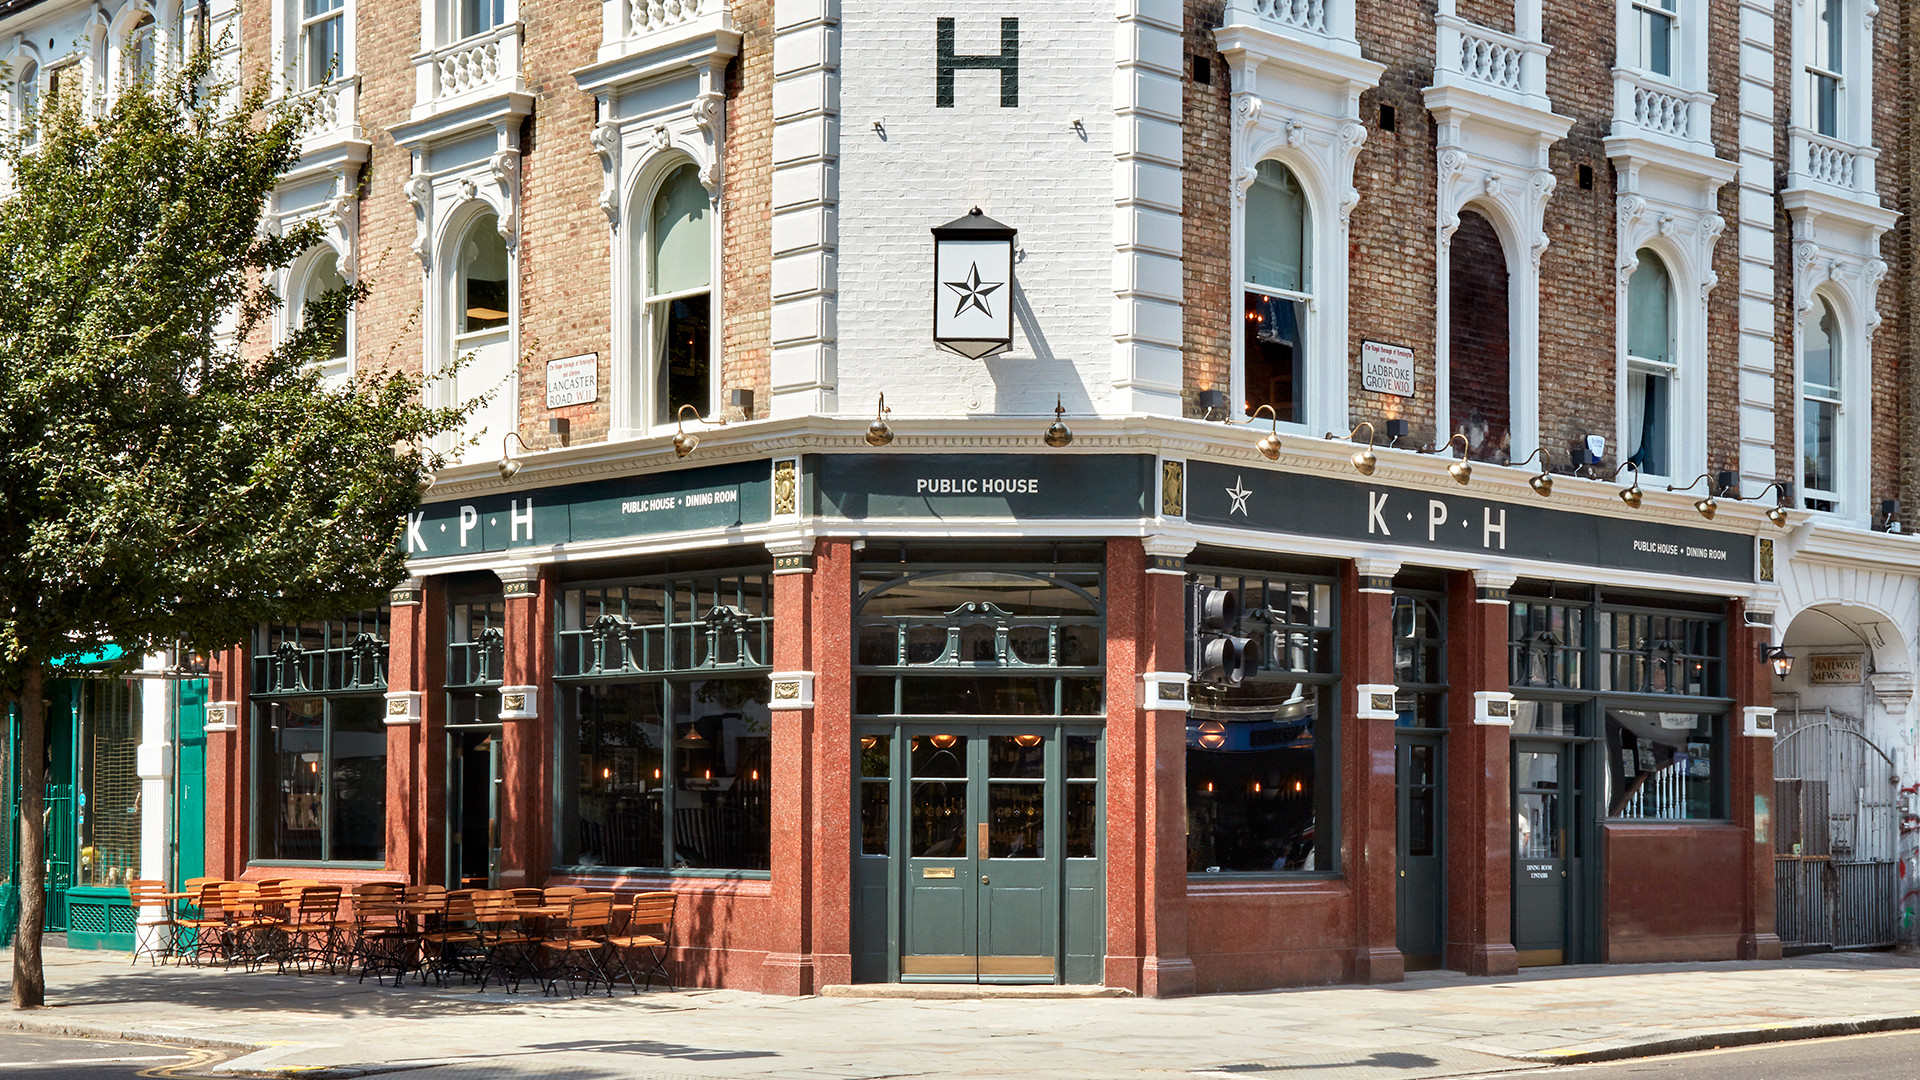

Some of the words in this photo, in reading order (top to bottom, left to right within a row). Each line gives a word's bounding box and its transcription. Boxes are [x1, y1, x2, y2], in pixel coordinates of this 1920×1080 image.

[936, 17, 1019, 108] H
[1367, 363, 1410, 380] LADBROKE
[549, 375, 595, 393] LANCASTER
[917, 479, 978, 493] PUBLIC
[982, 479, 1039, 493] HOUSE
[622, 501, 649, 514] PUBLIC
[650, 497, 676, 511] HOUSE
[685, 492, 713, 507] DINING
[714, 490, 737, 504] ROOM
[1633, 540, 1657, 552] PUBLIC
[1657, 543, 1678, 555] HOUSE
[1686, 546, 1708, 559] DINING
[1708, 549, 1727, 560] ROOM
